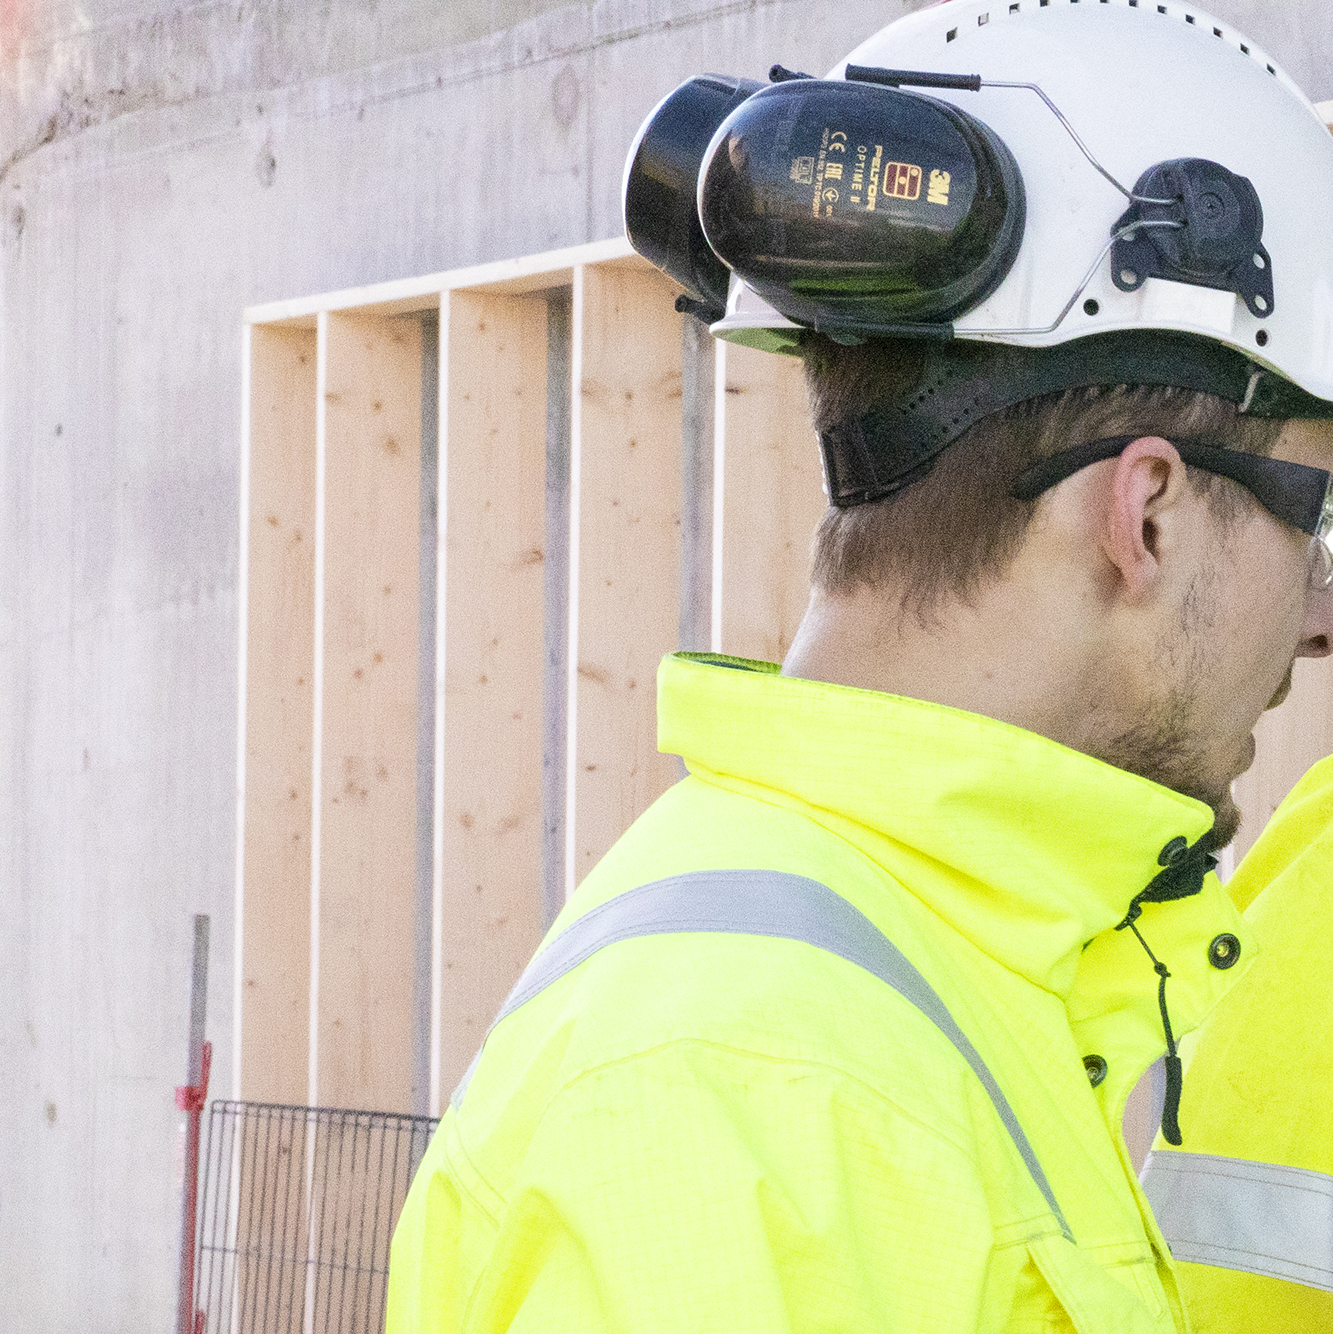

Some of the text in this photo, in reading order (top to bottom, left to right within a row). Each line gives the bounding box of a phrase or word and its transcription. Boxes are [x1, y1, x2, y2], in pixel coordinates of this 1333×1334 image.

[851, 145, 867, 191] OPTIME
[866, 145, 883, 211] PELTOR
[927, 169, 951, 206] 3M
